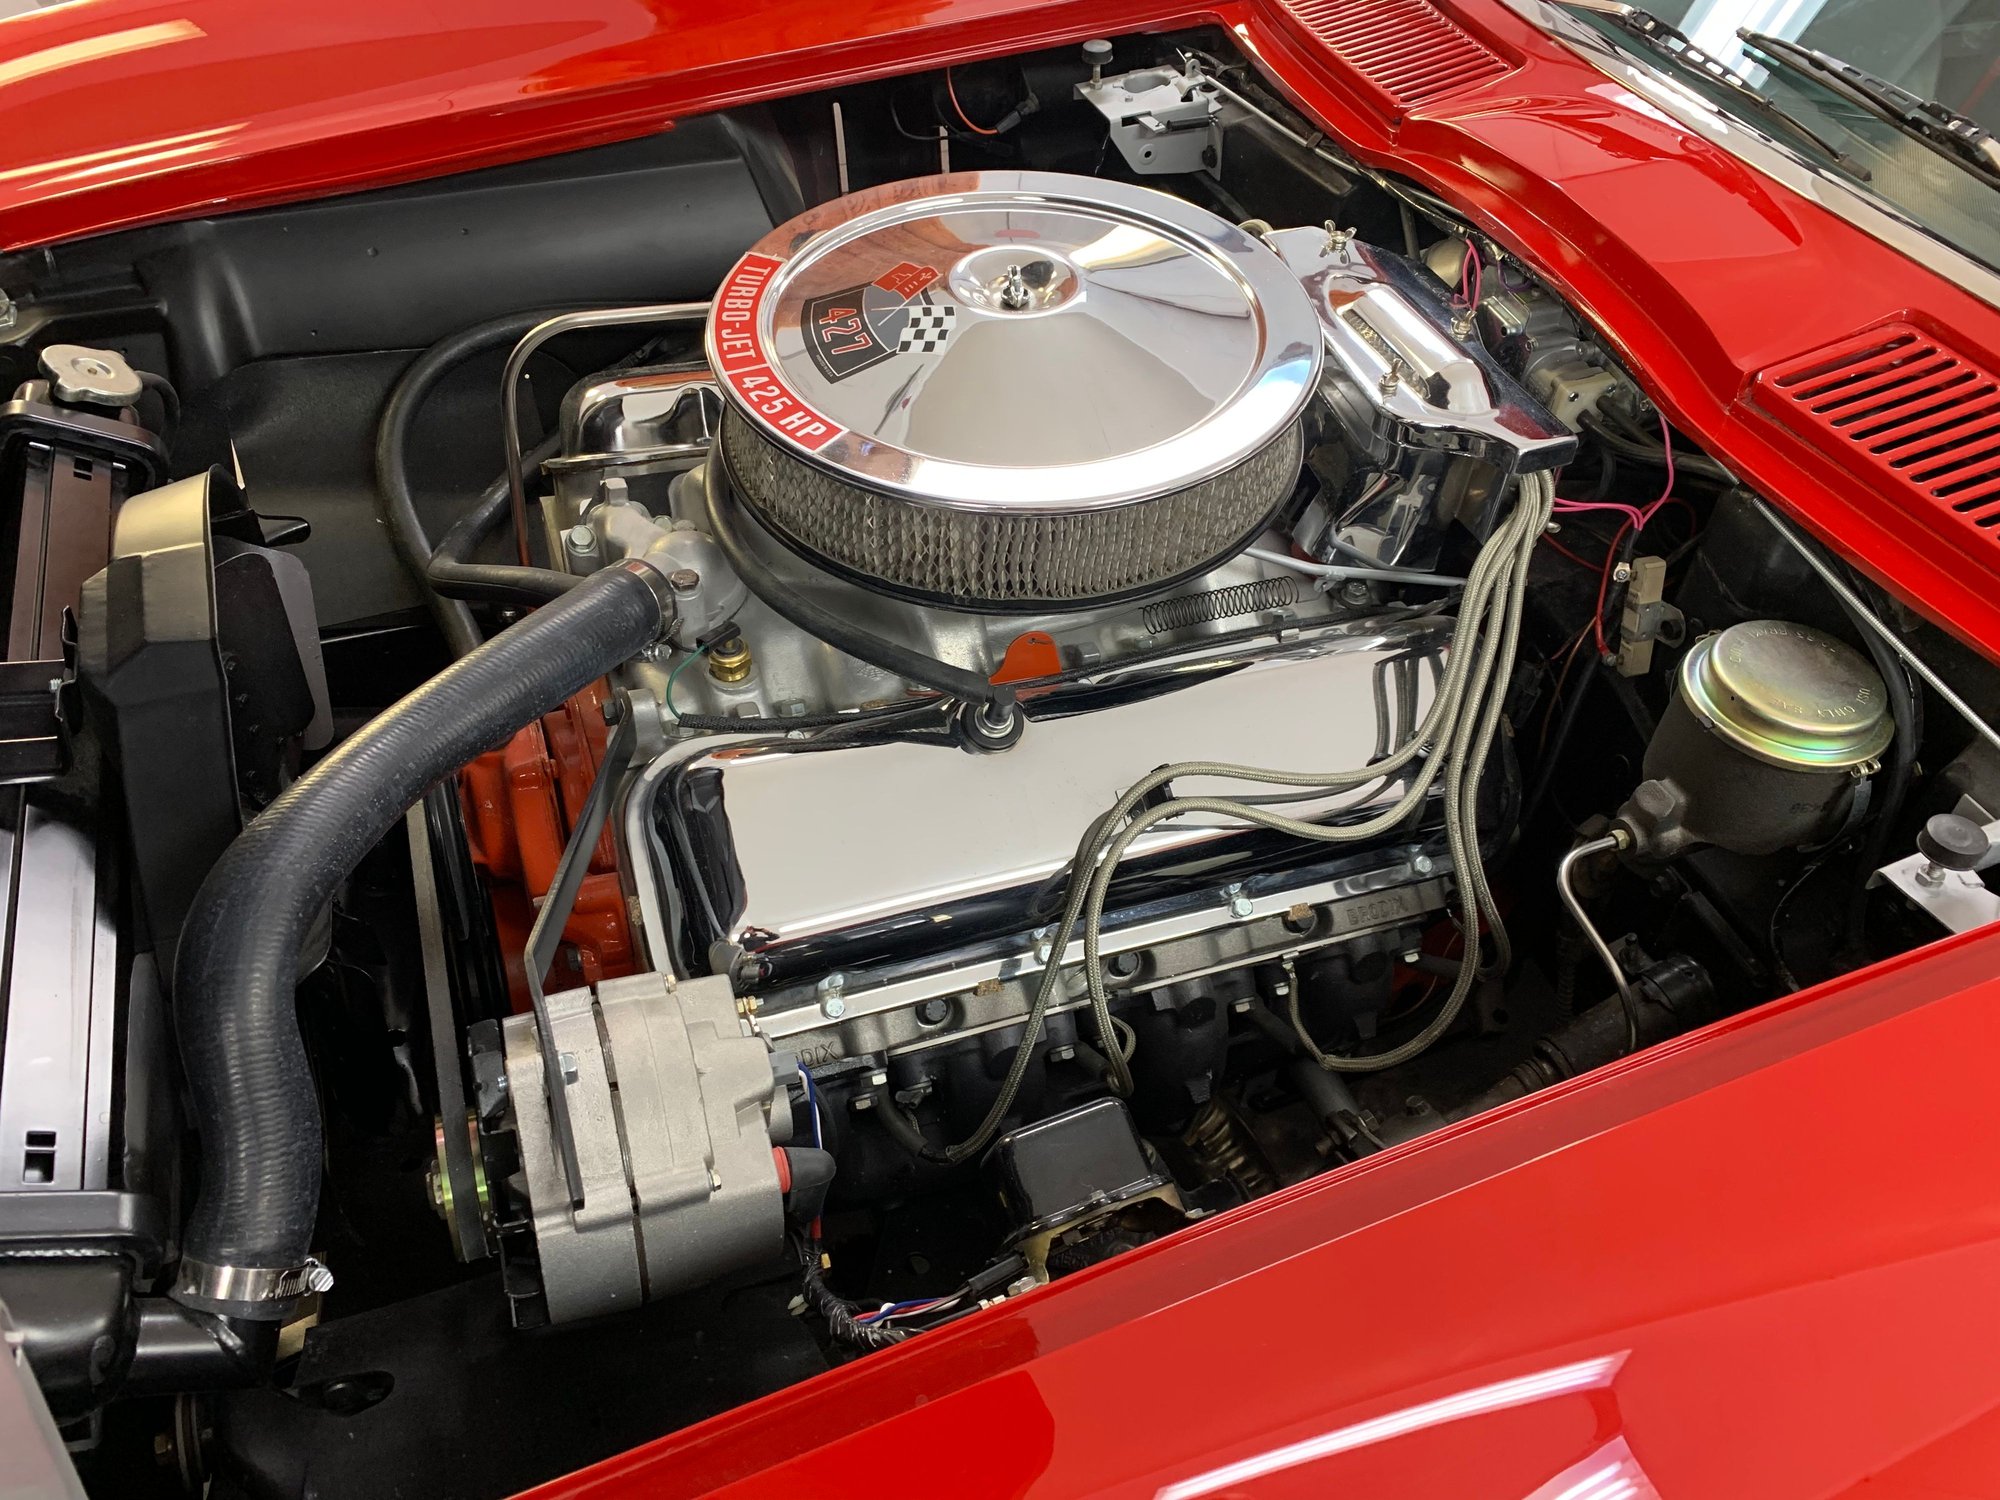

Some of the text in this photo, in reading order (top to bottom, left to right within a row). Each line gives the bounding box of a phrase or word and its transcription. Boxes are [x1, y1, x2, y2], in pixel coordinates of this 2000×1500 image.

[721, 265, 772, 360] TURBO-JET
[818, 307, 873, 355] 427
[741, 375, 792, 414] 425
[779, 409, 828, 438] HP
[1817, 705, 1856, 718] ONLY
[796, 1041, 840, 1067] DIX
